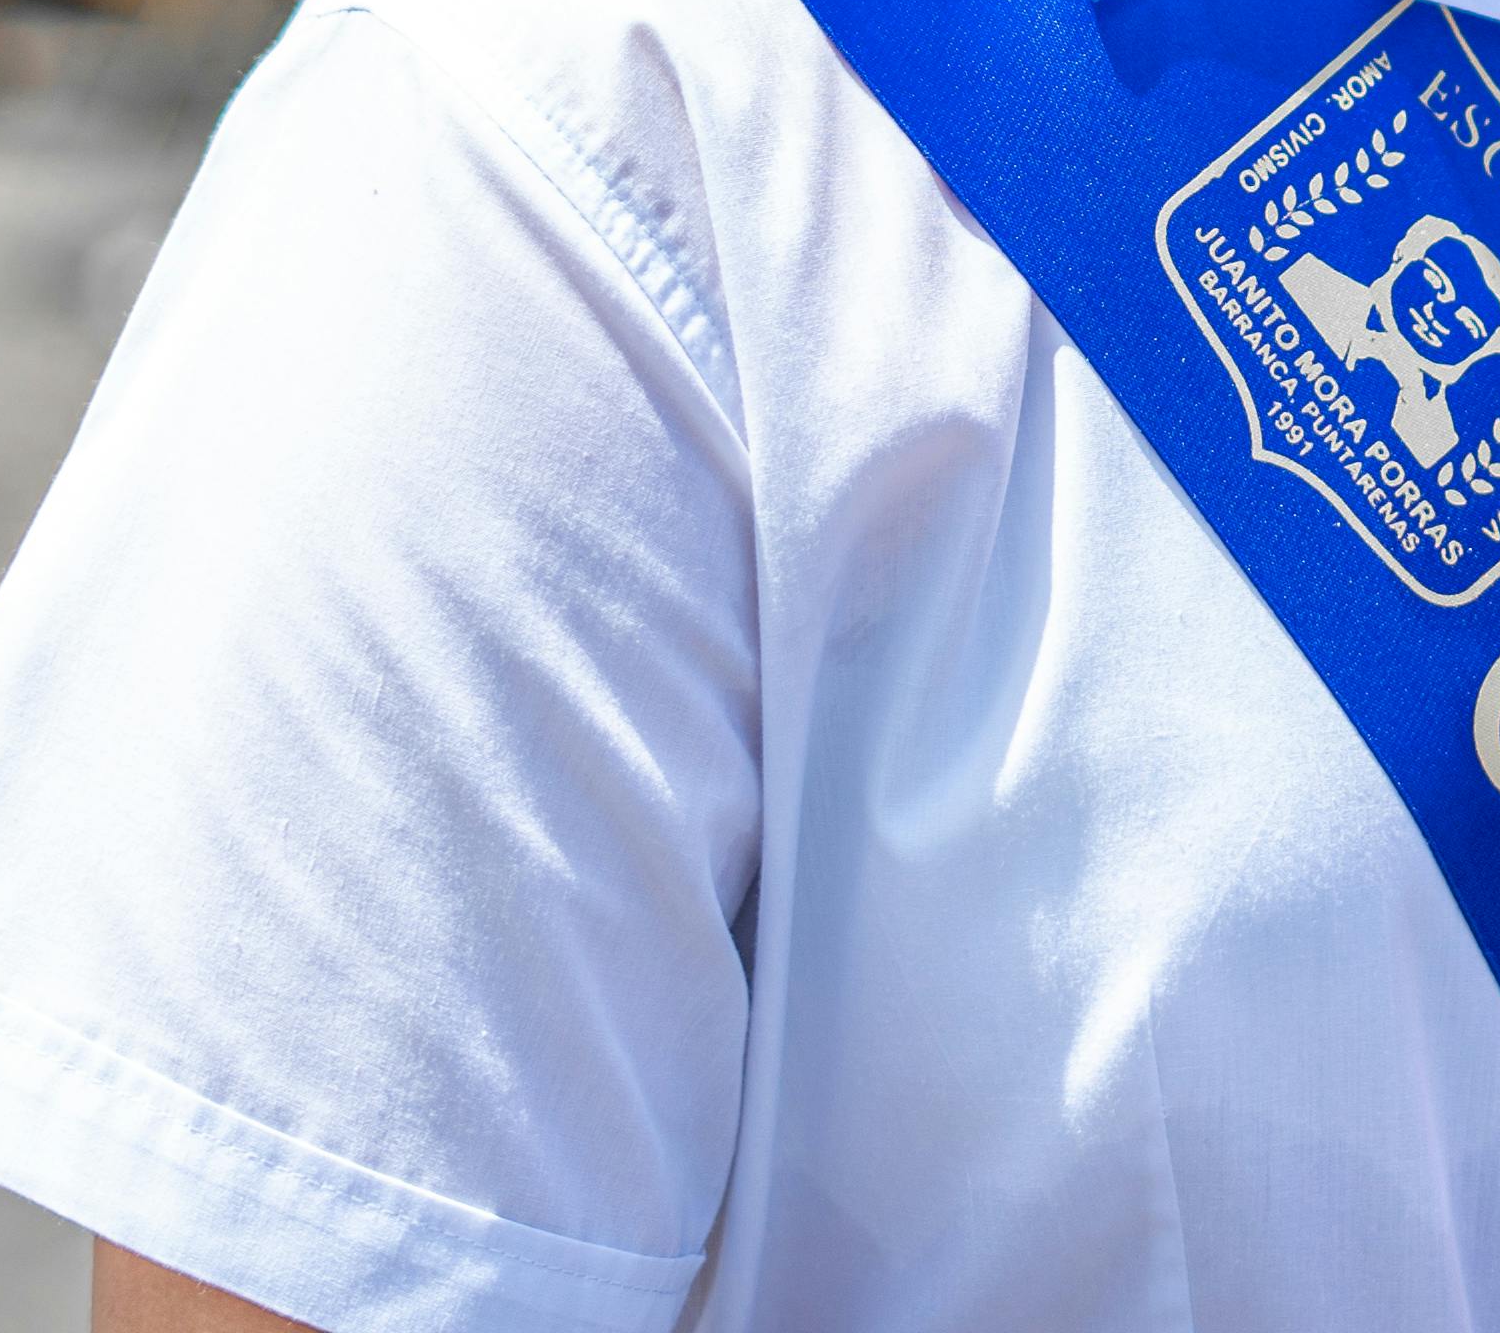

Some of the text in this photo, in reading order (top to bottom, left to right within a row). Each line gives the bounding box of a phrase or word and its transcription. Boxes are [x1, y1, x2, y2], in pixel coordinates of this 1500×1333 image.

[1238, 112, 1326, 193] CIVISMO
[1196, 228, 1463, 565] JUANITO MORA PORRAS
[1268, 402, 1313, 456] 1991
[1302, 401, 1419, 552] PUNTARENAS
